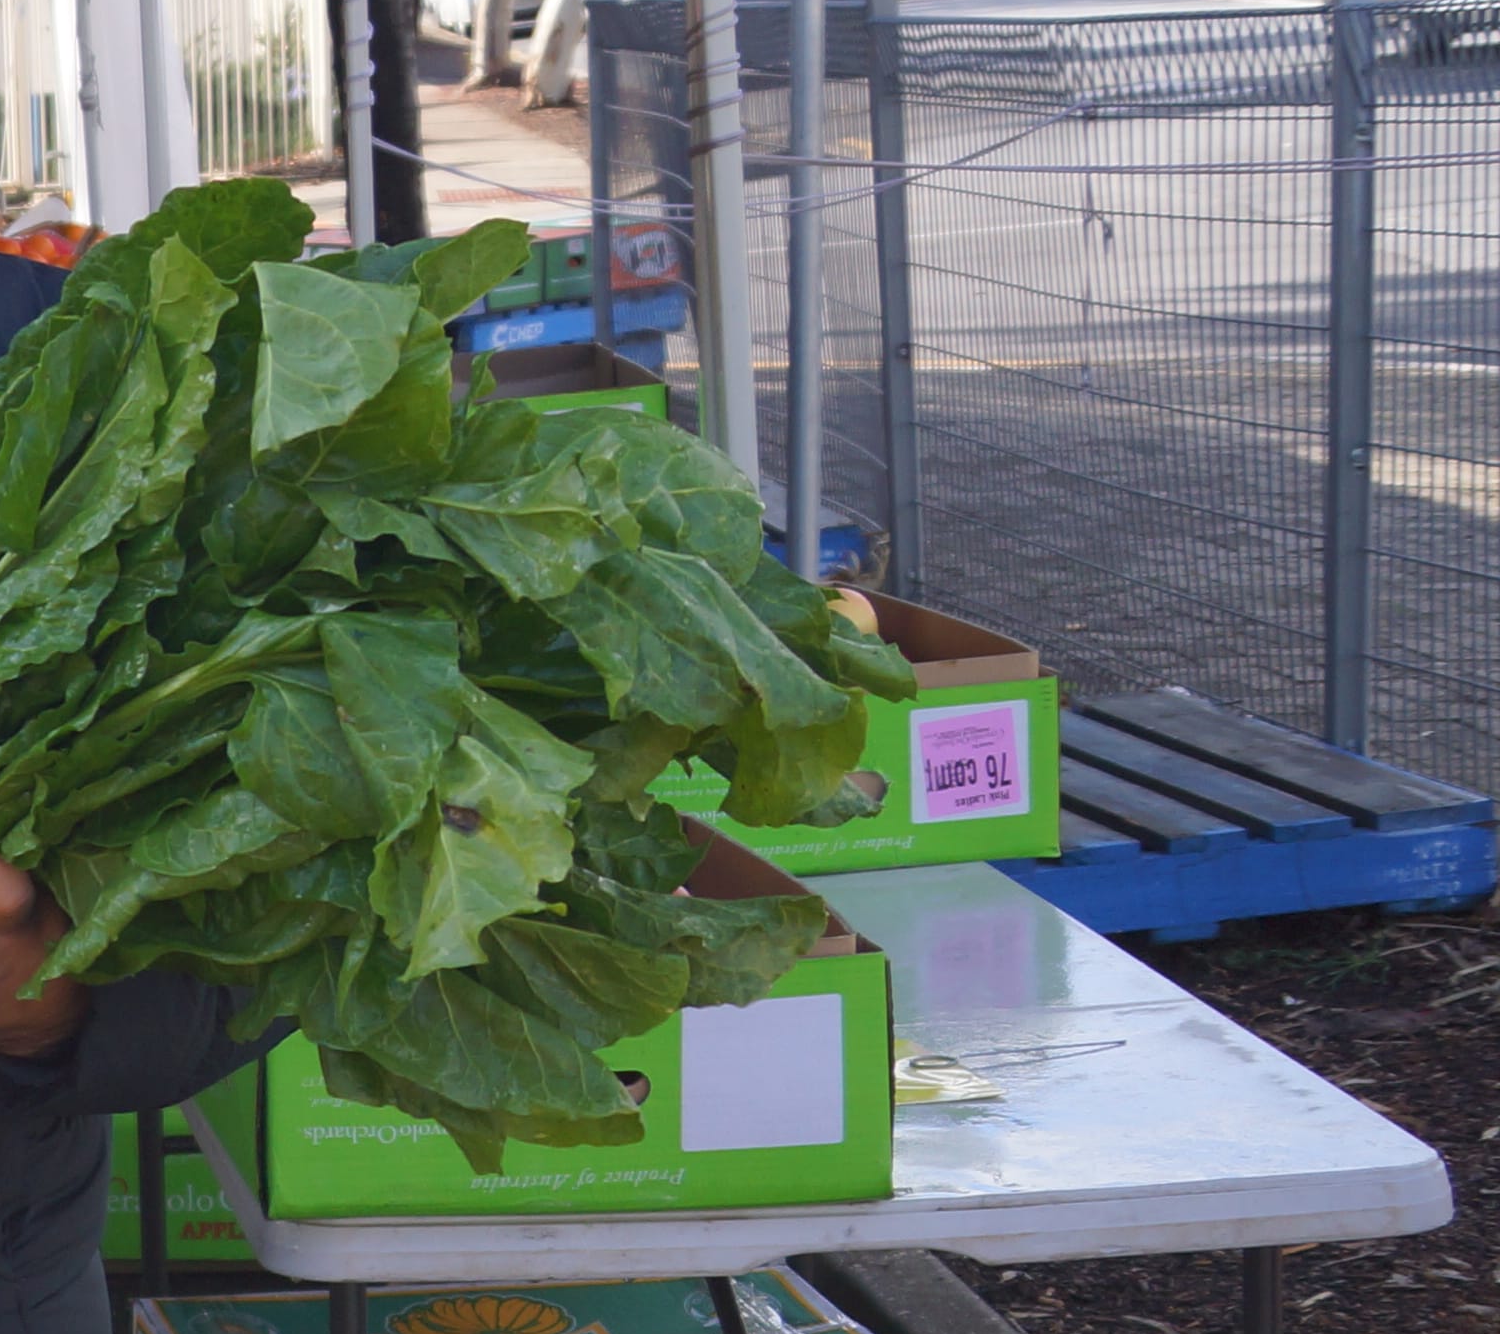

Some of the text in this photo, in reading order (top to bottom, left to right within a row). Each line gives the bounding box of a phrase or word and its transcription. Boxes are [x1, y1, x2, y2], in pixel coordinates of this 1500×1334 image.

[985, 751, 1012, 789] 76
[955, 790, 1010, 808] Pink Ladies
[303, 1123, 398, 1146] Orchards
[469, 1166, 687, 1194] Produce of Australia
